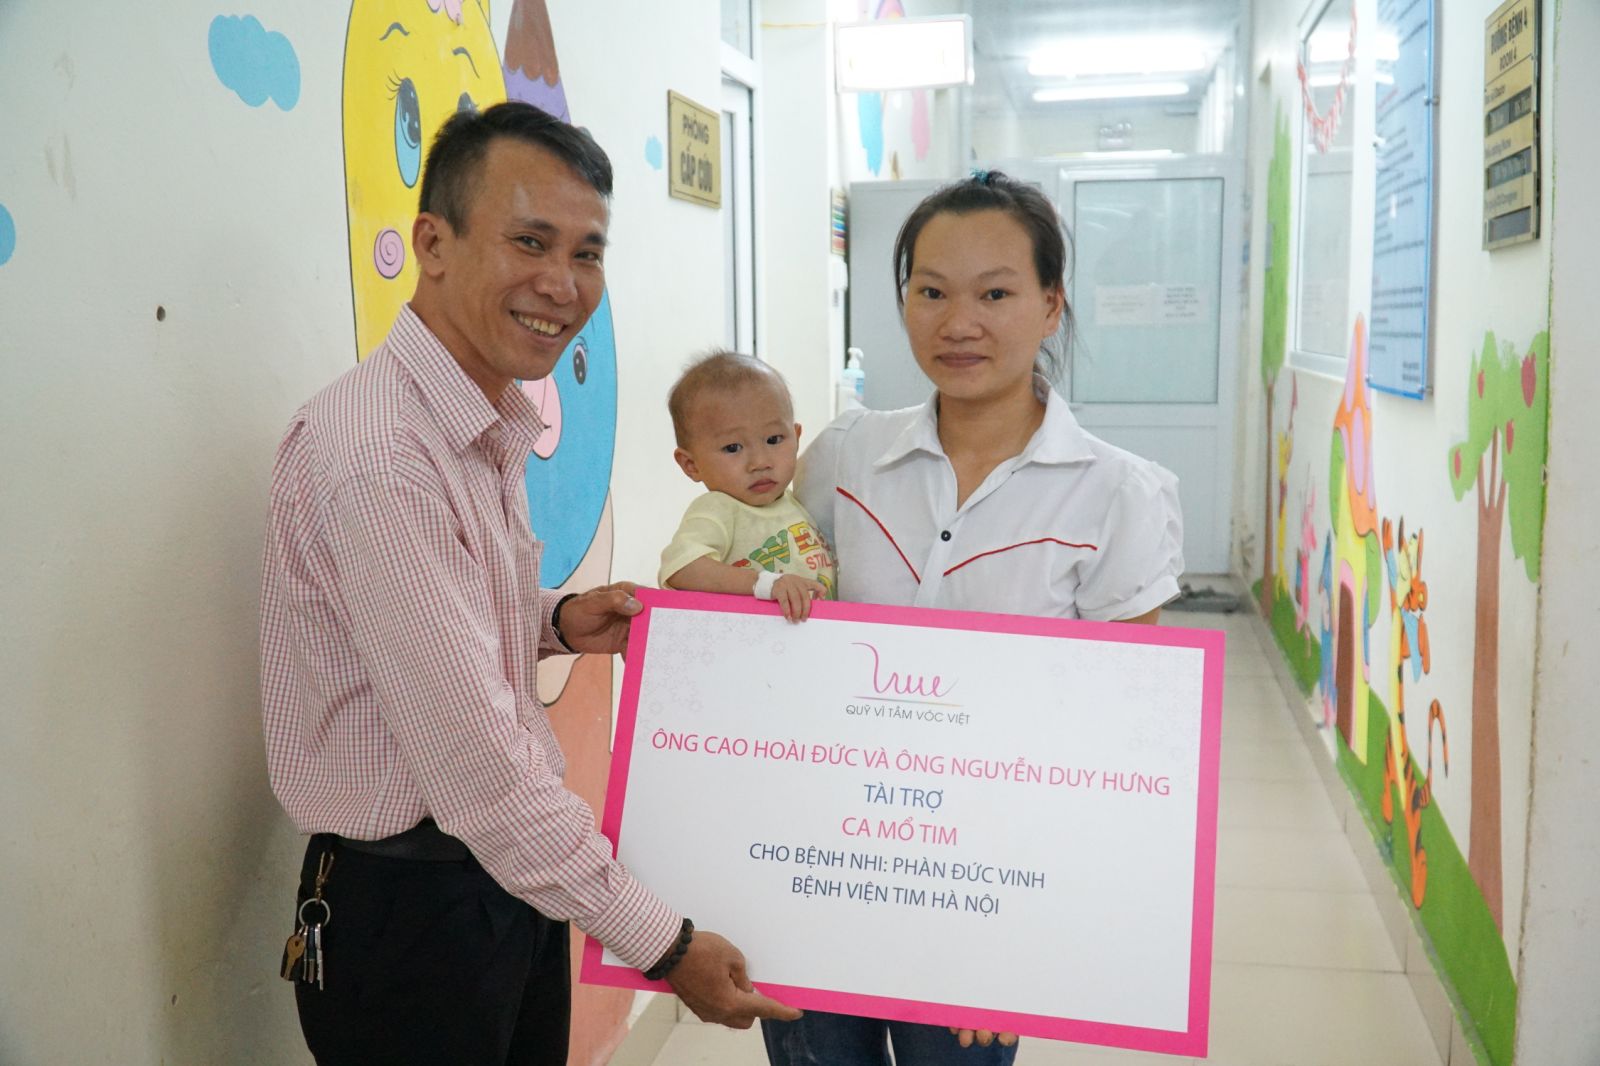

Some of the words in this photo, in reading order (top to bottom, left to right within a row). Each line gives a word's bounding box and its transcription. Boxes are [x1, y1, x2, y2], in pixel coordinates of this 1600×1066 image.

[681, 113, 710, 145] PHÒNG
[680, 144, 696, 187] CẤP
[846, 704, 871, 716] QUỸ
[916, 709, 945, 723] VÓC
[947, 712, 971, 726] VIỆT
[652, 728, 699, 752] ÔNG
[703, 735, 749, 756] CAO
[753, 739, 806, 762] HOÀI
[811, 743, 859, 767] ĐỨC
[863, 746, 889, 769] VÀ
[895, 749, 945, 775] ÔNG
[951, 757, 1043, 783] NGUYỄN
[1049, 766, 1096, 788] DUY
[1102, 771, 1171, 796] HƯNG
[863, 782, 894, 805] TÀI
[899, 788, 944, 813] TRỢ
[841, 816, 871, 838] CA
[877, 816, 915, 841] MỔ
[919, 823, 958, 846] TIM
[749, 843, 790, 862] CHO
[794, 845, 845, 868] BỆNH
[850, 853, 888, 872] NHI:
[893, 857, 946, 879] PHÀN
[951, 862, 995, 884] ĐỨC
[998, 868, 1046, 889] VINH
[791, 875, 842, 898] BỆNH
[846, 881, 889, 905] VIỆN
[893, 886, 926, 906] TIM
[931, 890, 959, 910] HÀ
[964, 893, 1000, 917] NỘI
